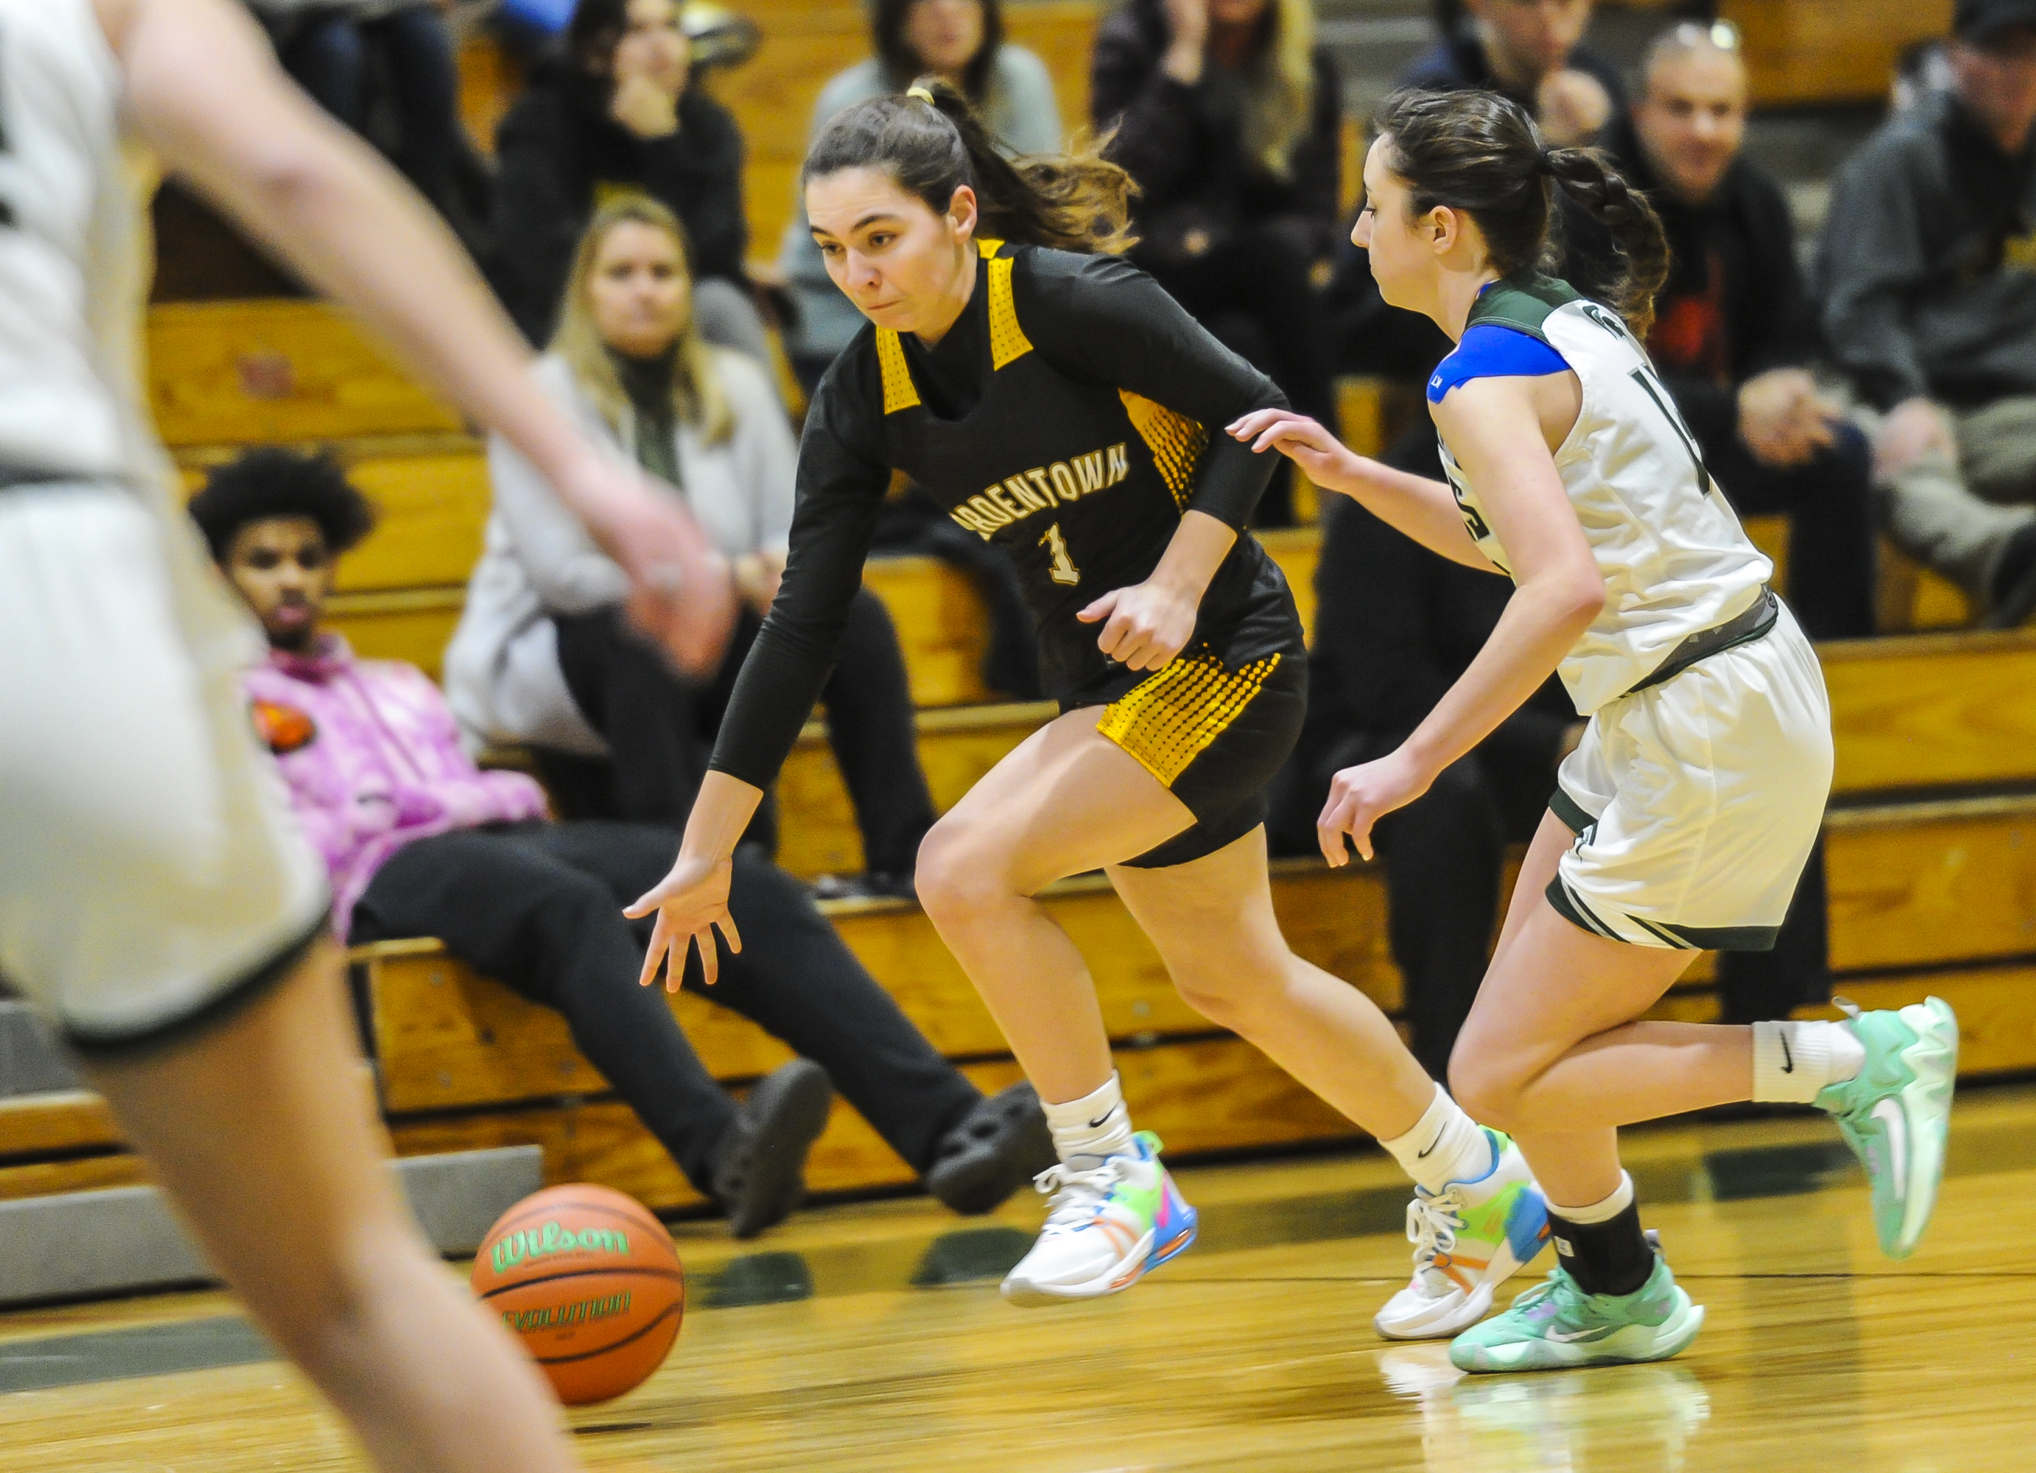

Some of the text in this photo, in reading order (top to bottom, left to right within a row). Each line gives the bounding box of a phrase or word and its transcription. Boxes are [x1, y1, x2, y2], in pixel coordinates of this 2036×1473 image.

[949, 442, 1130, 541] RDENTOWN
[1038, 522, 1080, 585] 1
[490, 1221, 630, 1274] Wilson
